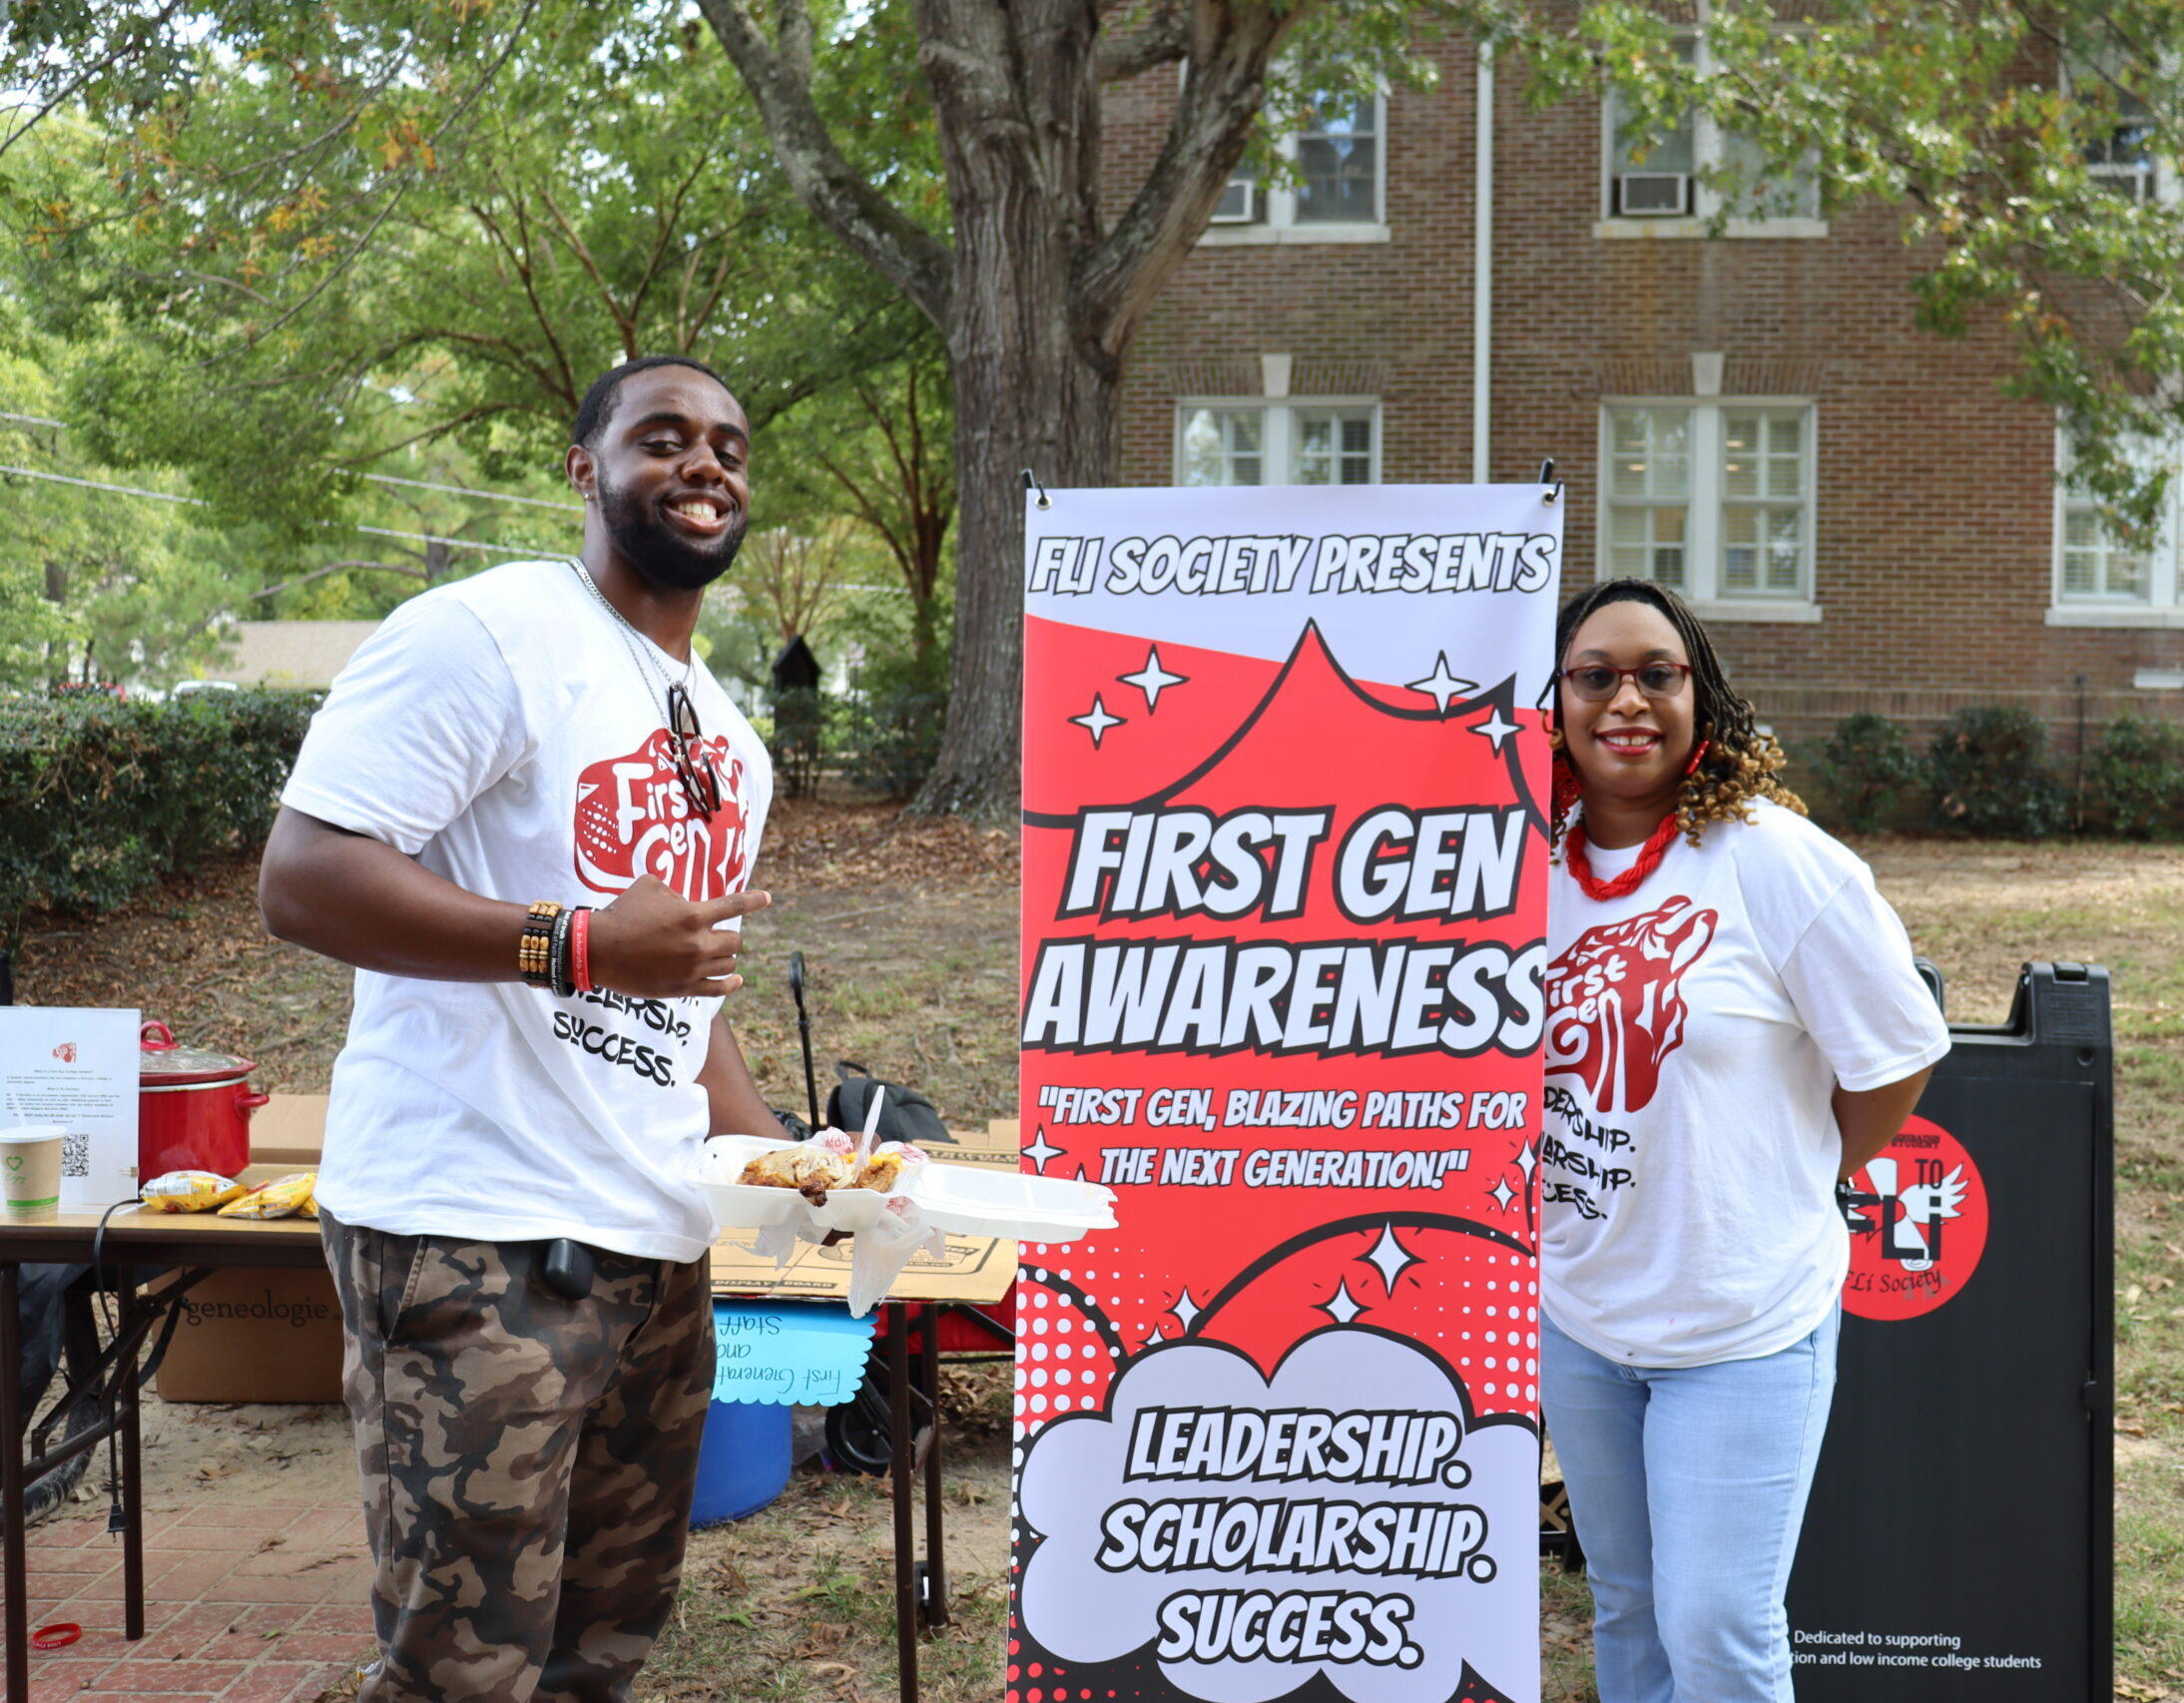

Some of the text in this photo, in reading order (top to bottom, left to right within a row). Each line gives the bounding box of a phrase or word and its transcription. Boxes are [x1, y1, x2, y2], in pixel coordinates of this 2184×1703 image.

[1029, 532, 1556, 596] FLI SOCIETY PRESENTS
[612, 763, 706, 845] Firs
[1057, 804, 1530, 924] FIRST GEN
[1021, 937, 1546, 1058] AWARENESS
[553, 1011, 676, 1087] SUCCESS.
[1038, 1086, 1528, 1131] "FIRST GEN, BLAZING PATHS FOR
[1100, 1148, 1470, 1190] THE NEXT GENERATION!"
[1914, 1158, 1943, 1189] TO
[1880, 1270, 1942, 1295] Society
[187, 1288, 328, 1328] geneologie
[719, 1316, 783, 1336] Staff
[803, 1368, 841, 1396] First
[1124, 1406, 1472, 1488] LEADERSHIP.
[1096, 1497, 1496, 1583] SCHOLARSHIP.
[1157, 1589, 1424, 1669] SUCCESS.
[1794, 1630, 1961, 1650] Dedicated to supporting
[1820, 1651, 1846, 1665] and
[1850, 1651, 1875, 1666] low
[1878, 1653, 1928, 1667] income
[1930, 1654, 1980, 1671] college
[1983, 1655, 2042, 1669] students
